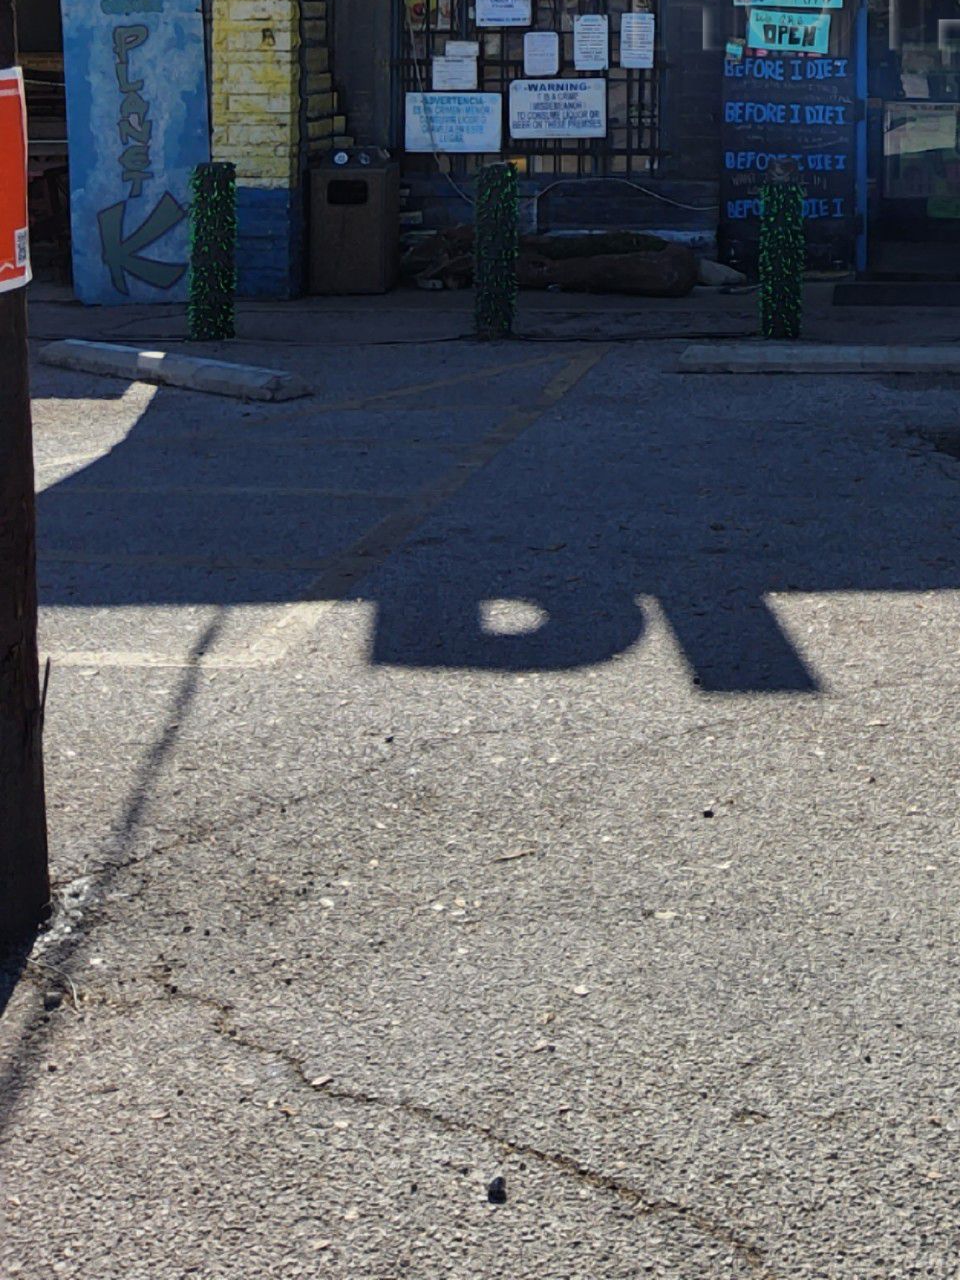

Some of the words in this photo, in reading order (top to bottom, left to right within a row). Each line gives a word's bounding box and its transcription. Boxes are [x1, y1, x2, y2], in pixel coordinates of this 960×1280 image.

[763, 24, 817, 46] OPEN
[724, 58, 784, 80] BEFORE
[790, 59, 802, 80] I
[807, 59, 833, 79] DIE
[112, 23, 154, 198] PLANET
[725, 102, 786, 123] BEFORE
[790, 104, 801, 124] I
[805, 104, 833, 125] DIE
[96, 190, 190, 296] K
